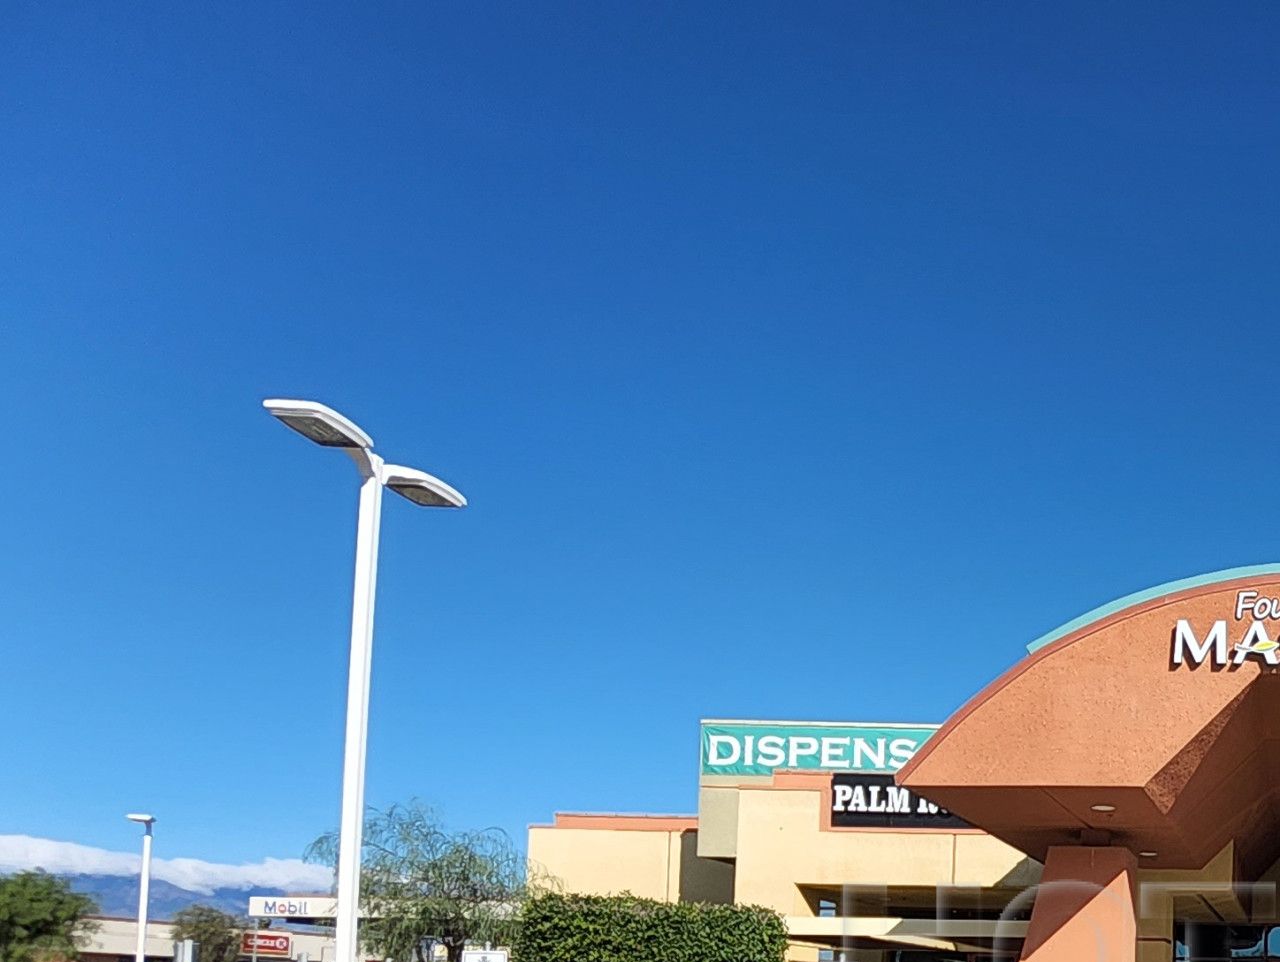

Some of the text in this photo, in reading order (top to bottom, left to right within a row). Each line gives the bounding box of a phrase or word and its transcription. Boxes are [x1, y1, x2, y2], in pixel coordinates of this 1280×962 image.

[707, 734, 918, 769] DISPENS
[833, 785, 911, 813] PALM
[264, 901, 308, 915] Mobil
